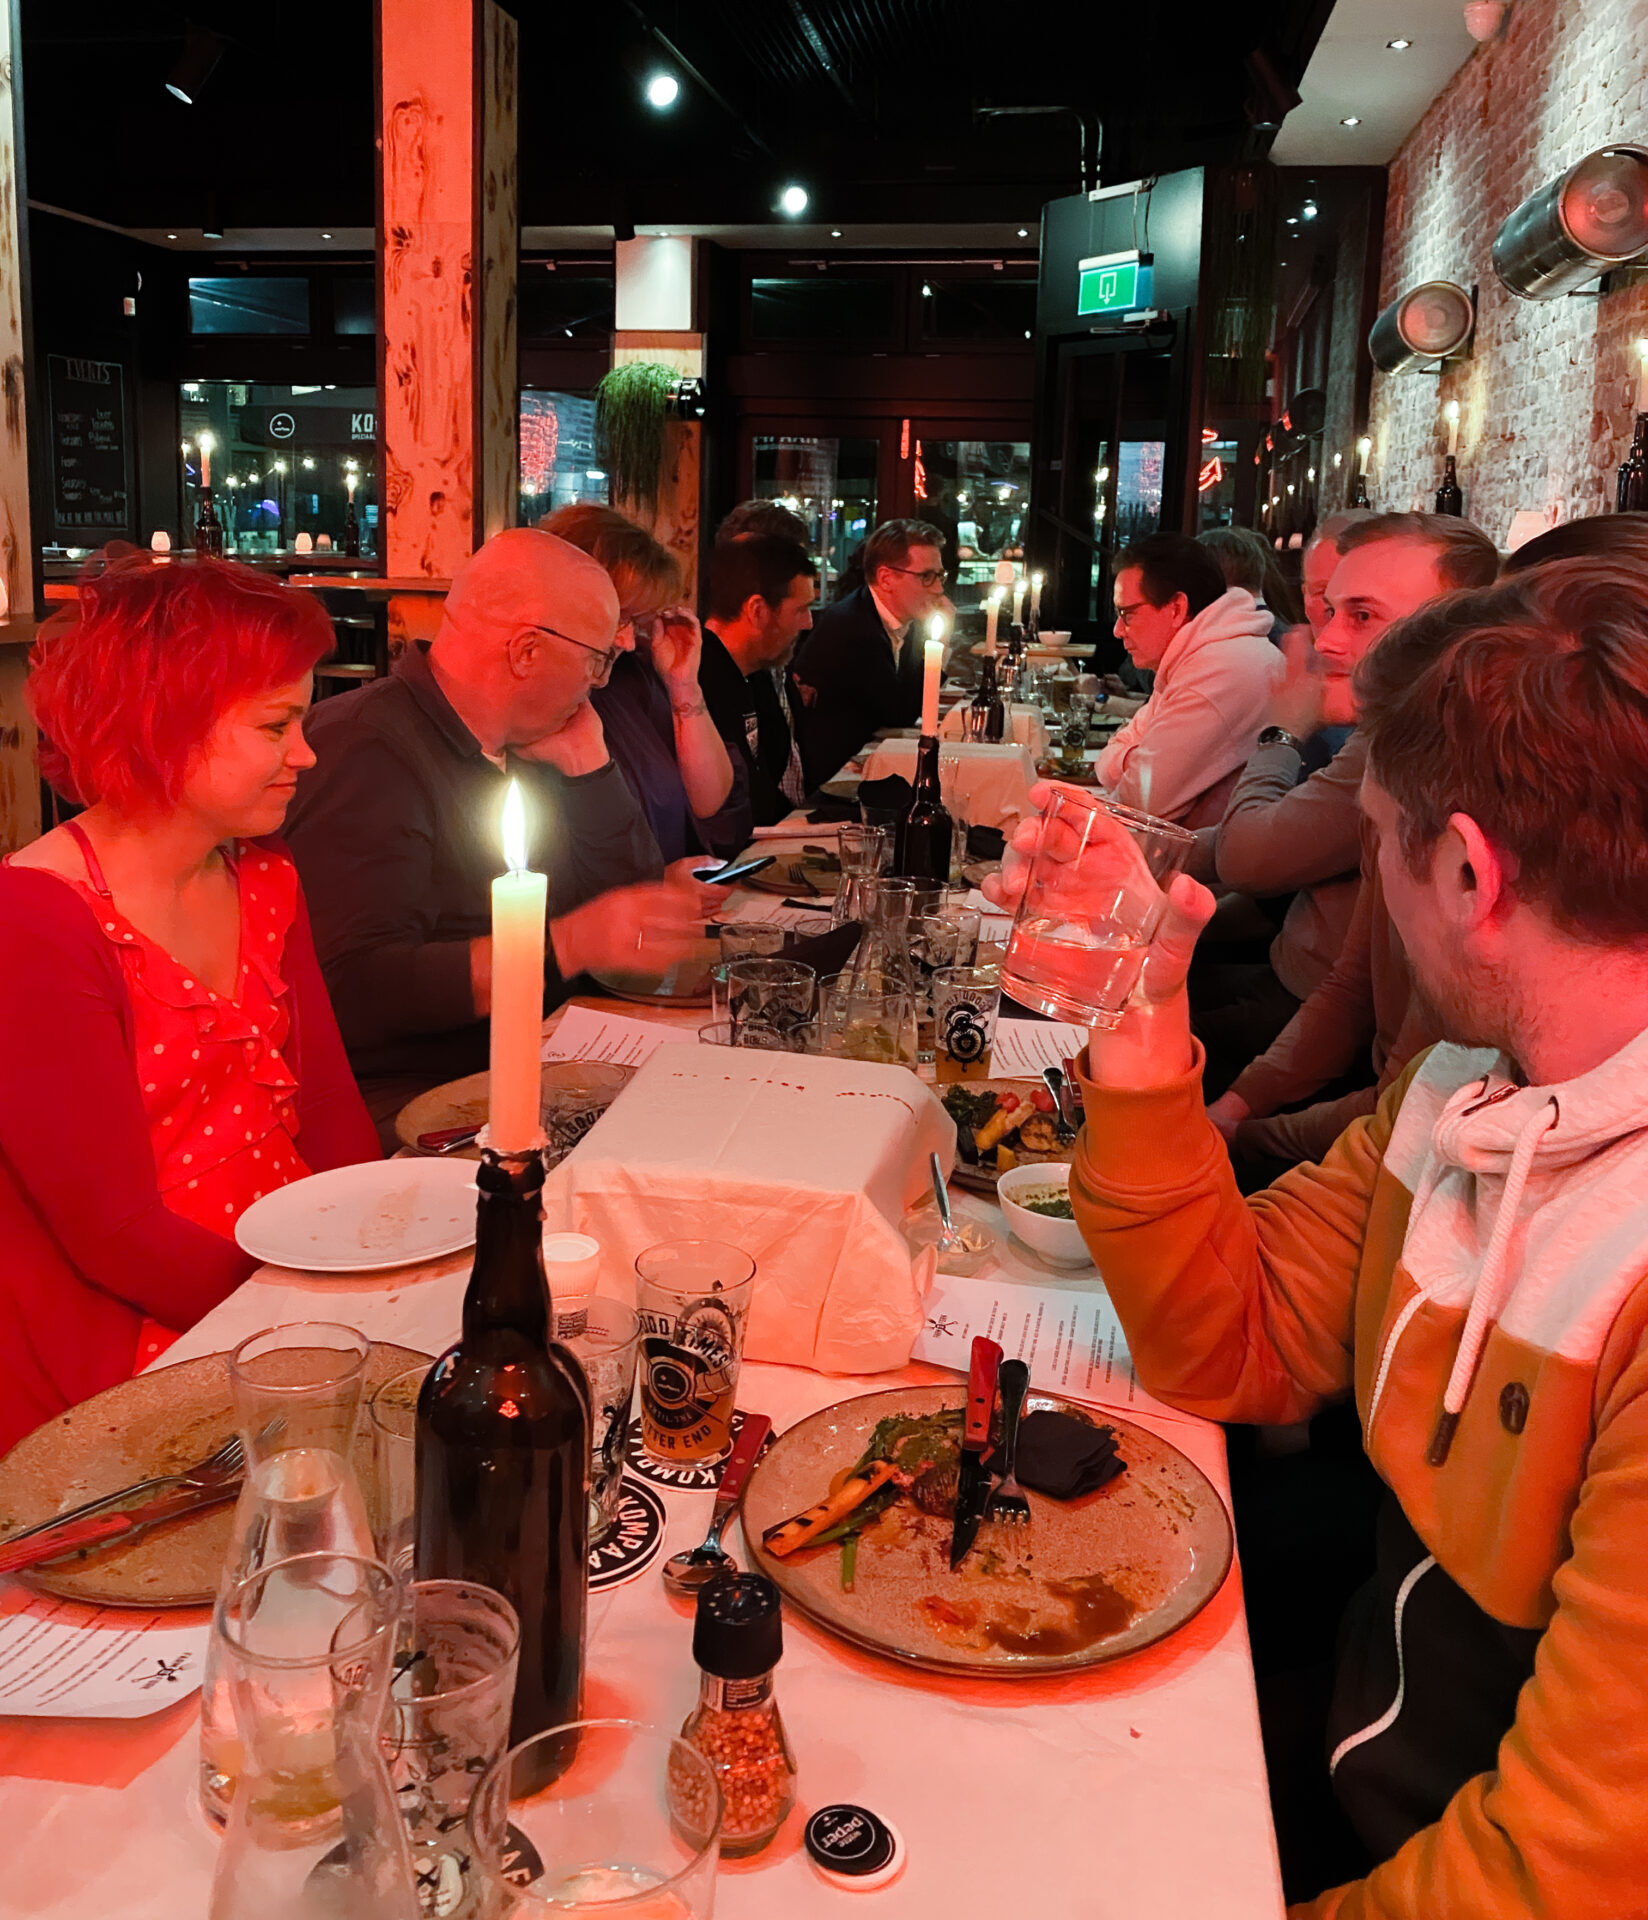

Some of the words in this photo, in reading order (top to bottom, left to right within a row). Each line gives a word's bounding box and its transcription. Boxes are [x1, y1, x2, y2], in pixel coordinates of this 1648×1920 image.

[66, 359, 111, 383] EVENTS
[352, 413, 377, 433] KO
[640, 1315, 670, 1335] OOD
[679, 1326, 728, 1369] TIMES
[683, 1424, 711, 1449] END
[588, 1495, 650, 1569] KOMPAA
[821, 1816, 864, 1849] peper
